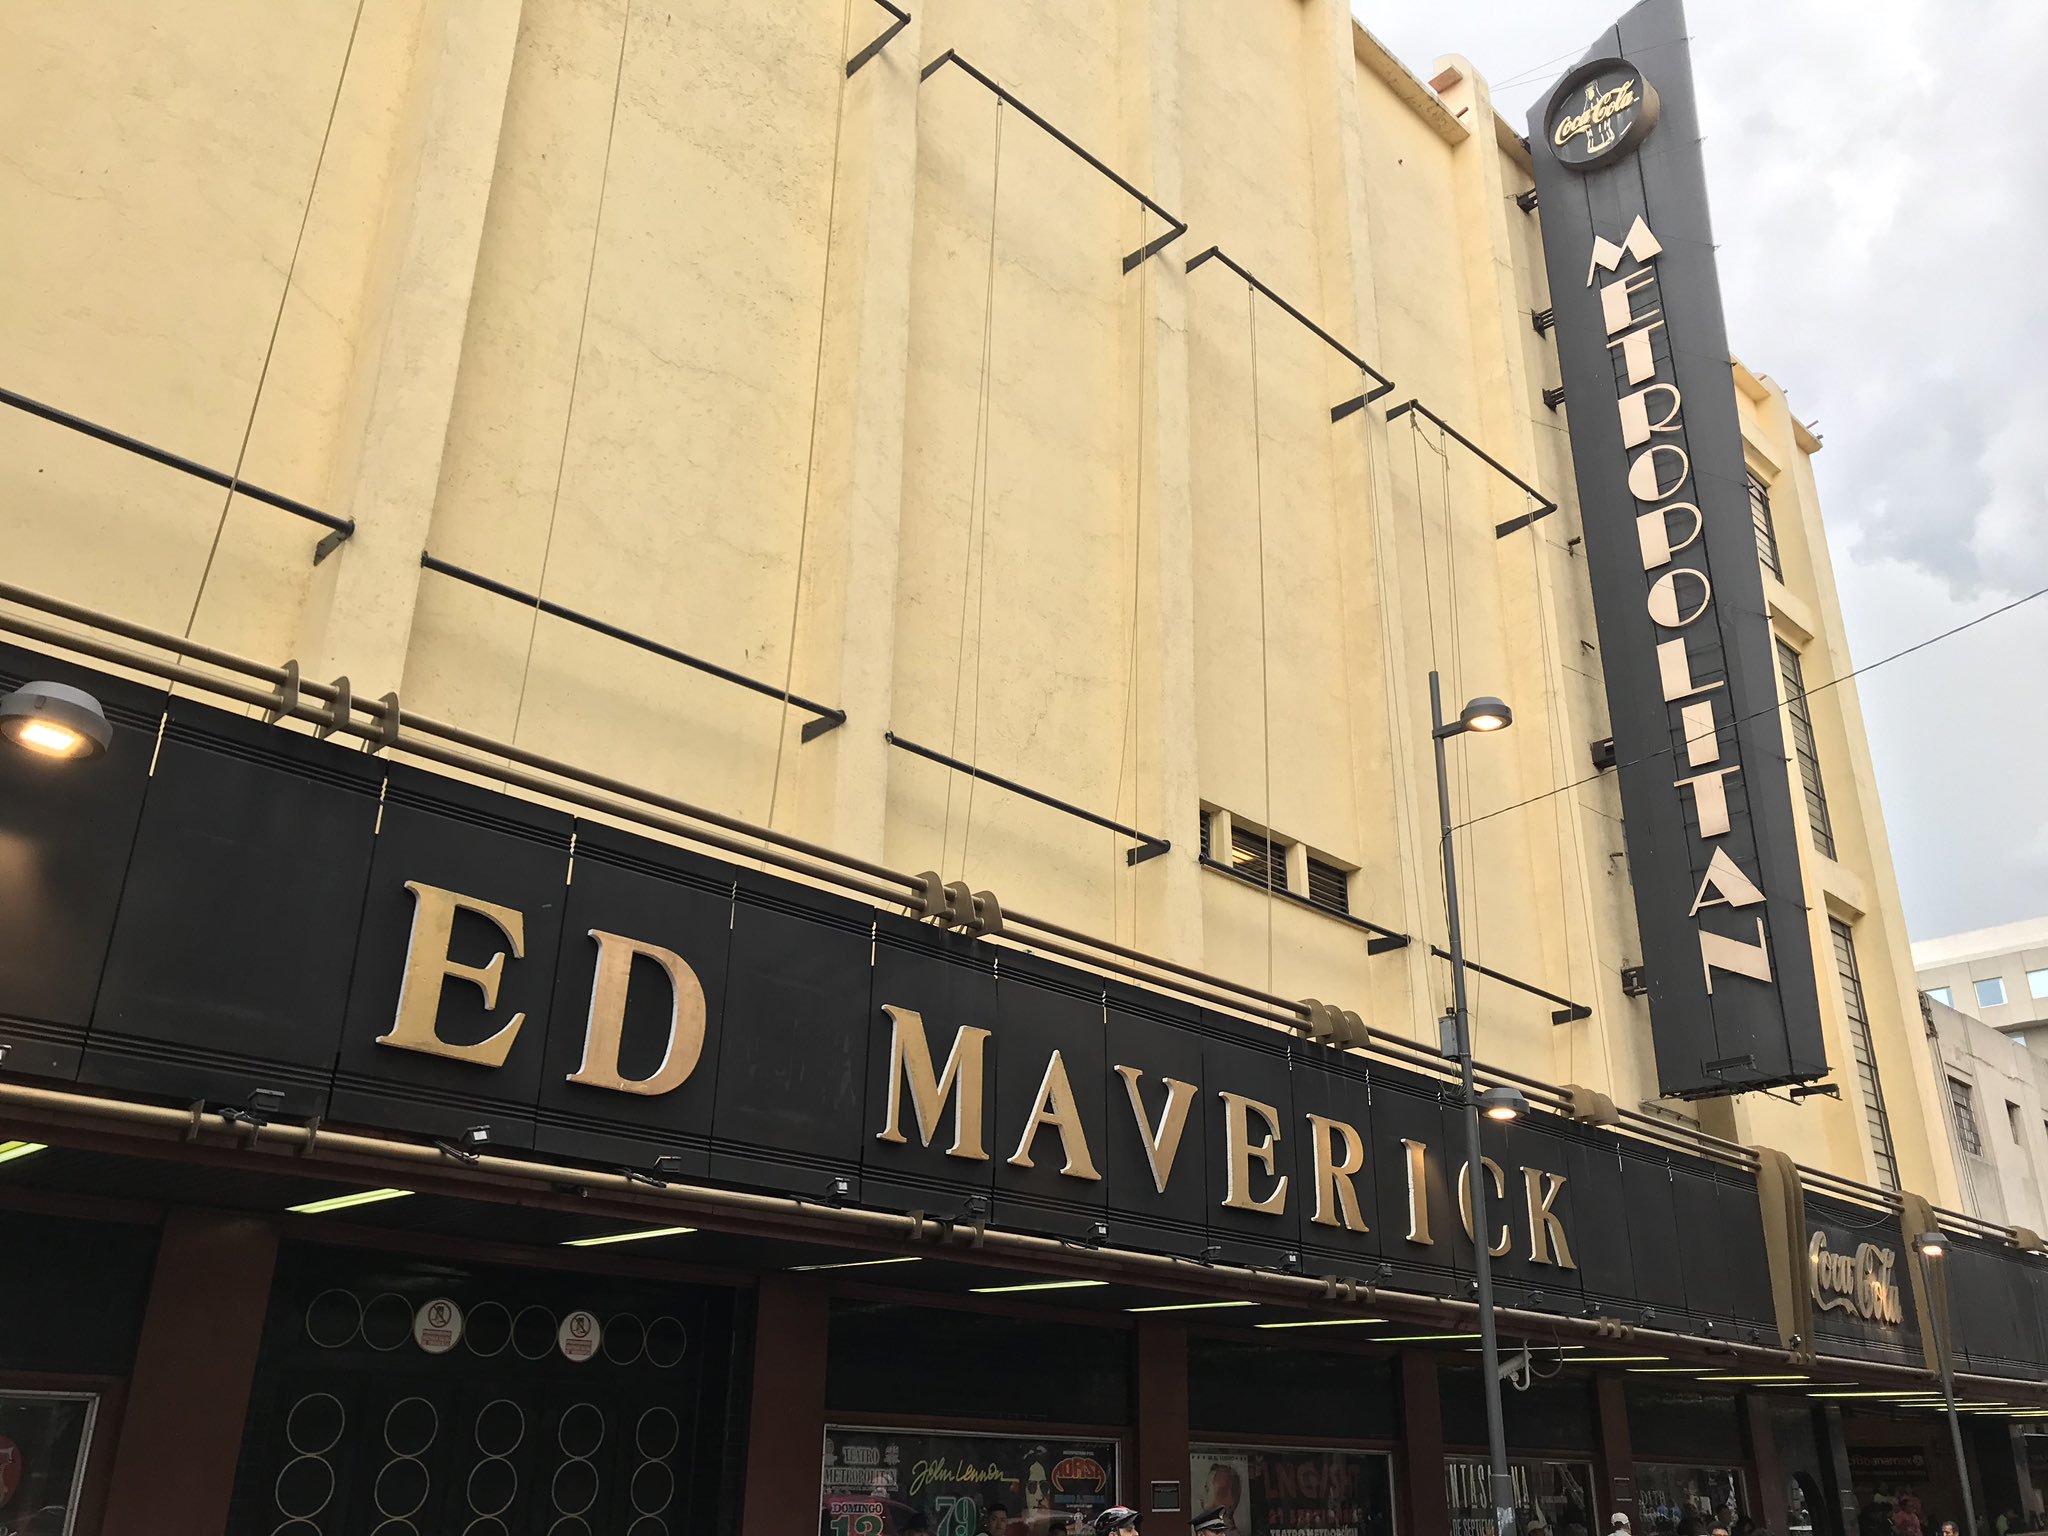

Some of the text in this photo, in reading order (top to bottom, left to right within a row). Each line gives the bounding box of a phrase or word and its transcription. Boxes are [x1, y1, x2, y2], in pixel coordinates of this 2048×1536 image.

[1586, 213, 1773, 996] METROPOLITAN
[375, 879, 1577, 1270] ED MAVERICK
[830, 1501, 884, 1515] DOMINGO
[935, 1495, 977, 1536] 79
